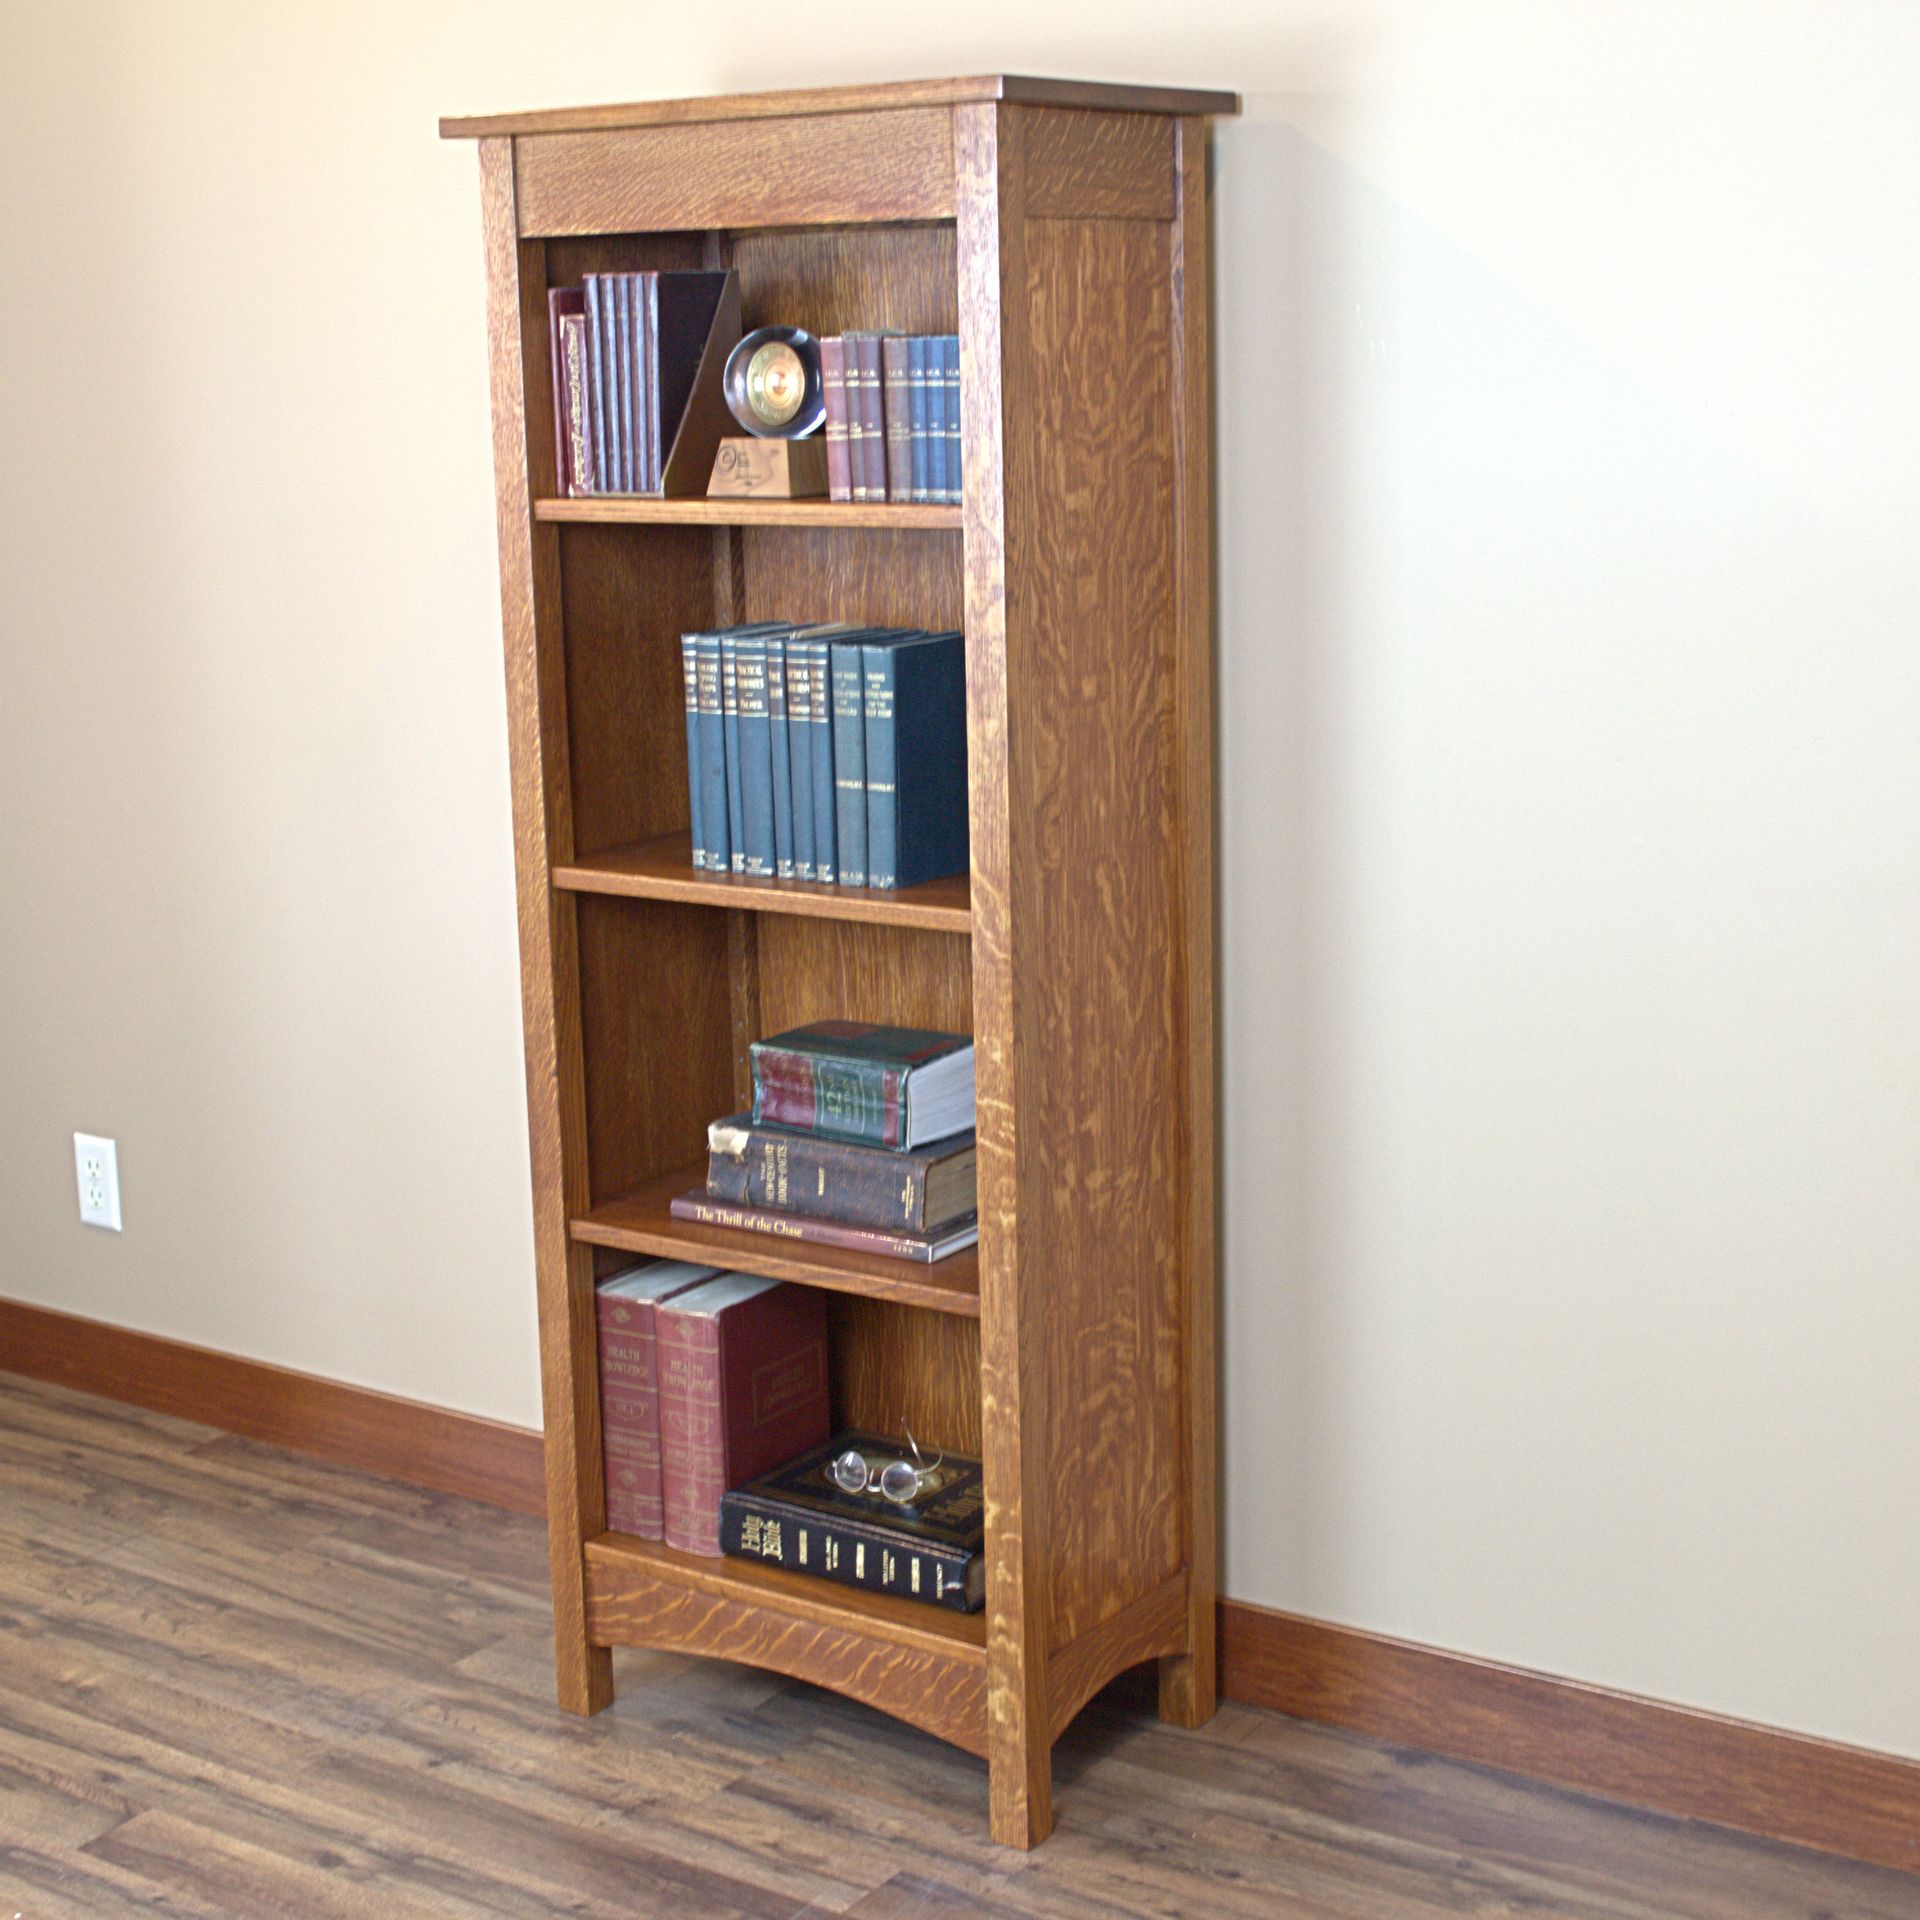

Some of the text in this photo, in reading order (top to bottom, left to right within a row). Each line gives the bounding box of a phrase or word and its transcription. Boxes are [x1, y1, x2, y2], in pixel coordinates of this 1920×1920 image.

[695, 1205, 802, 1238] The Thrill of the Chase
[607, 1345, 640, 1363] HEALTH
[670, 1359, 703, 1377] HEALTH
[741, 1515, 764, 1552] Holy
[762, 1520, 783, 1561] Bible
